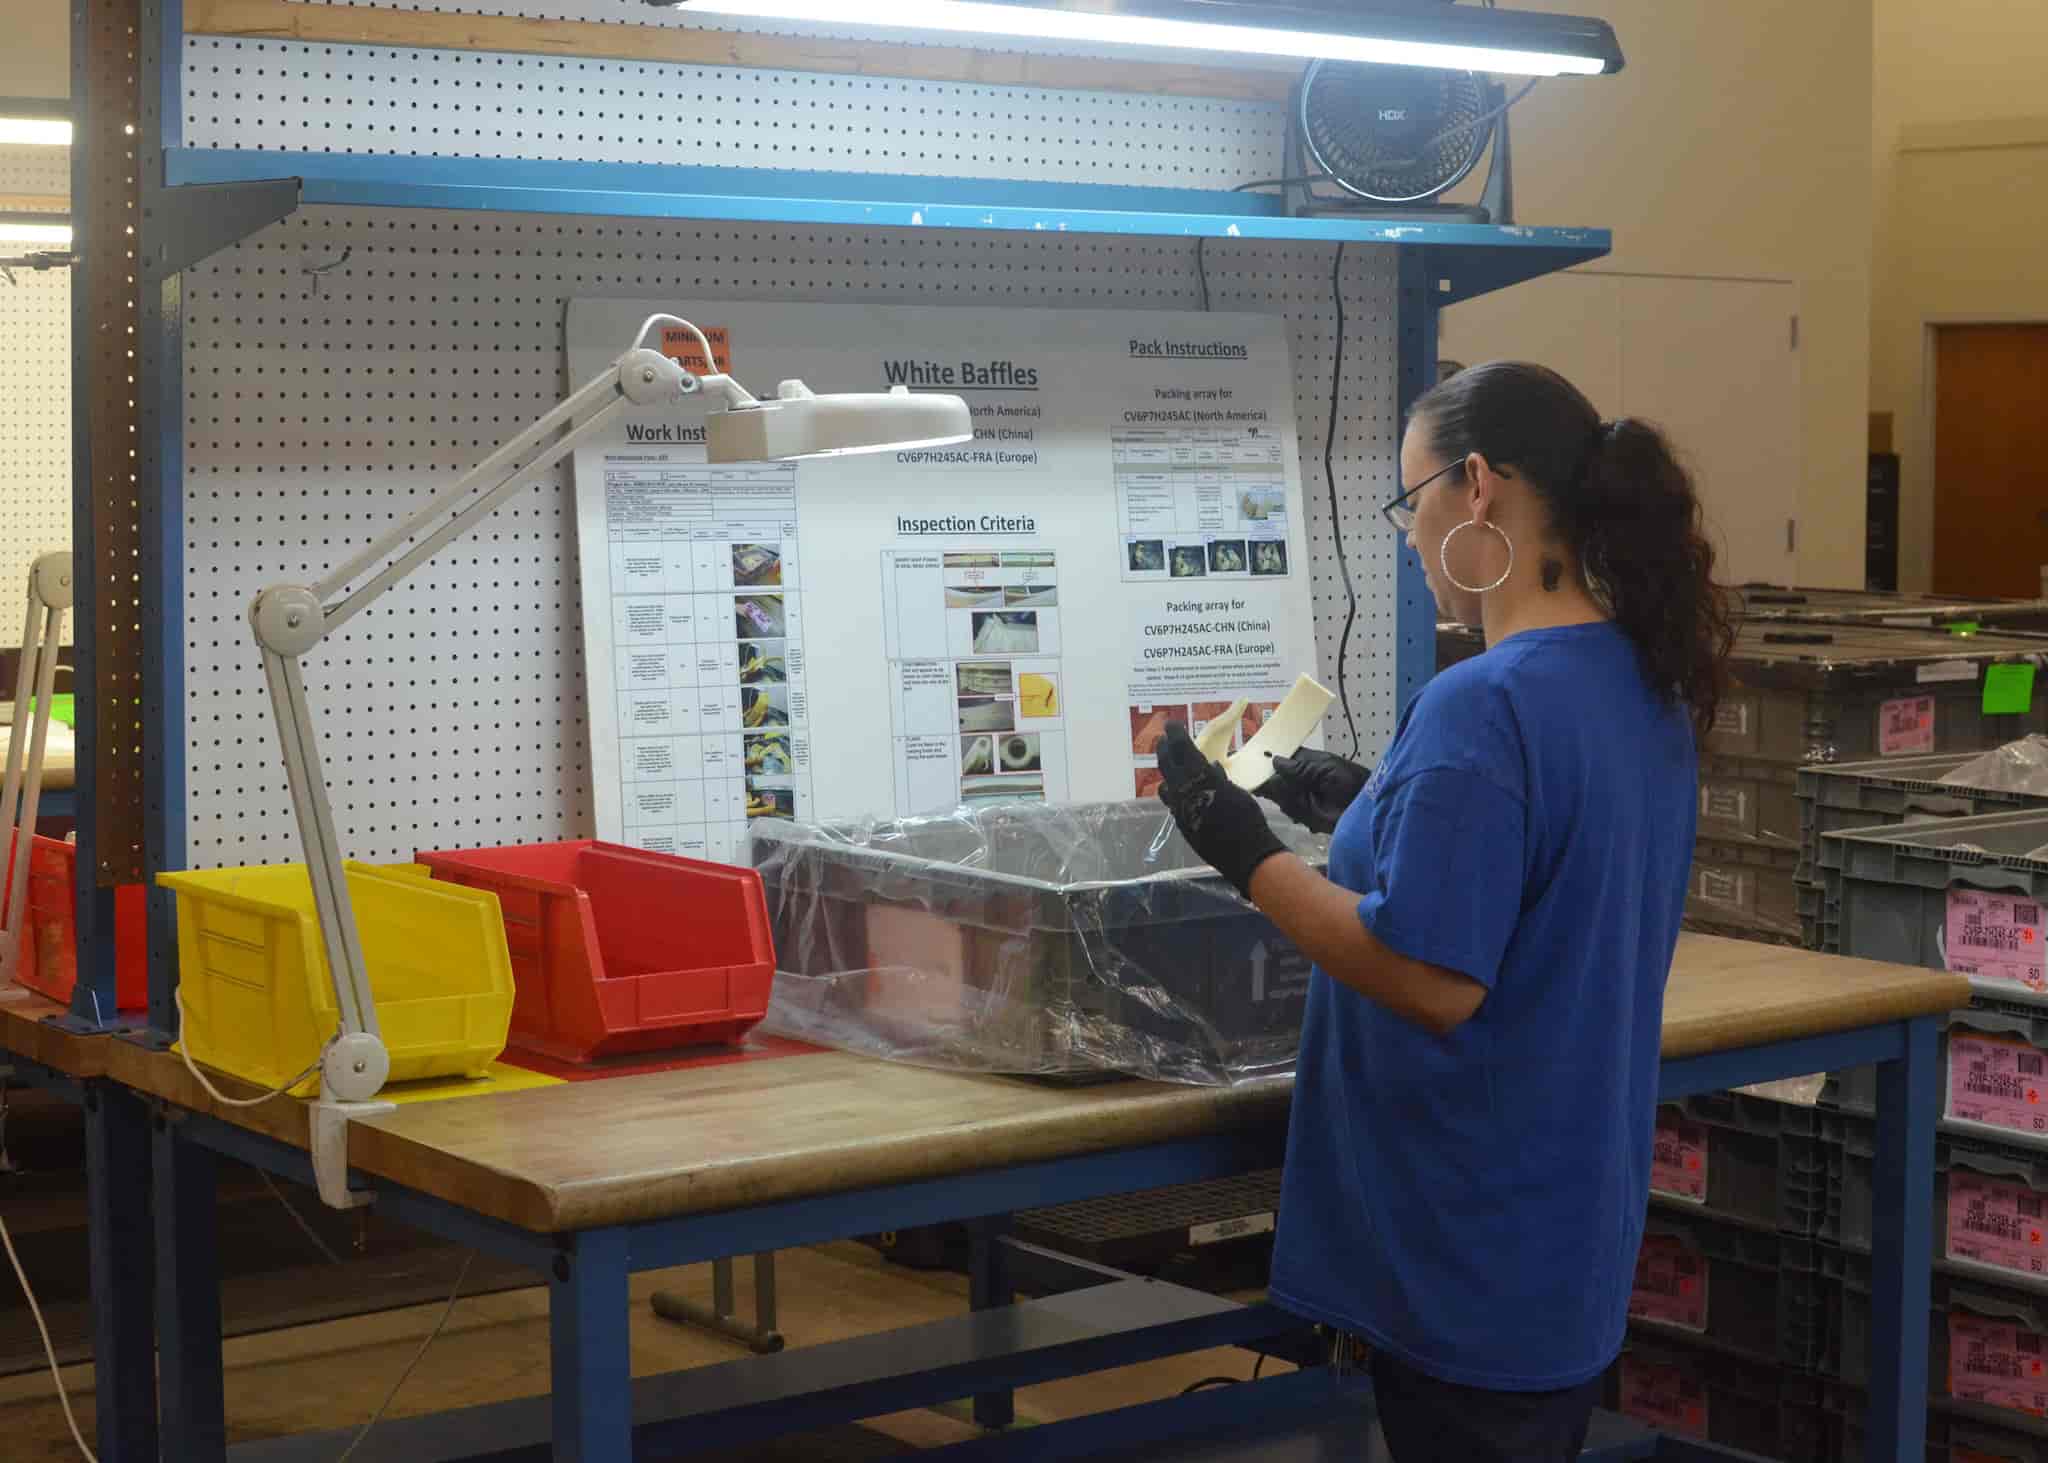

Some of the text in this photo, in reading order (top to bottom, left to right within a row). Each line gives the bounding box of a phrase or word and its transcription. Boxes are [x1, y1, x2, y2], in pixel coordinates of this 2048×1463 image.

[1377, 109, 1407, 121] HDX
[666, 332, 725, 344] MINIUM
[1129, 339, 1248, 357] Pack Instructions
[884, 360, 1038, 386] White Baffles
[1154, 387, 1233, 401] Packing array for
[997, 404, 1041, 418] America)
[1193, 409, 1224, 424] (North
[1226, 409, 1268, 424] America)
[626, 424, 707, 441] Work Inst
[973, 428, 1034, 442] CHN (China)
[995, 450, 1038, 465] (Europe)
[897, 515, 1035, 534] Inspection Criteria
[1166, 599, 1246, 614] Packing array for
[1144, 620, 1271, 636] CV6P7H245AC-CHN (China)
[1143, 642, 1275, 659] CV6P7H245AC-FRA (Europe)
